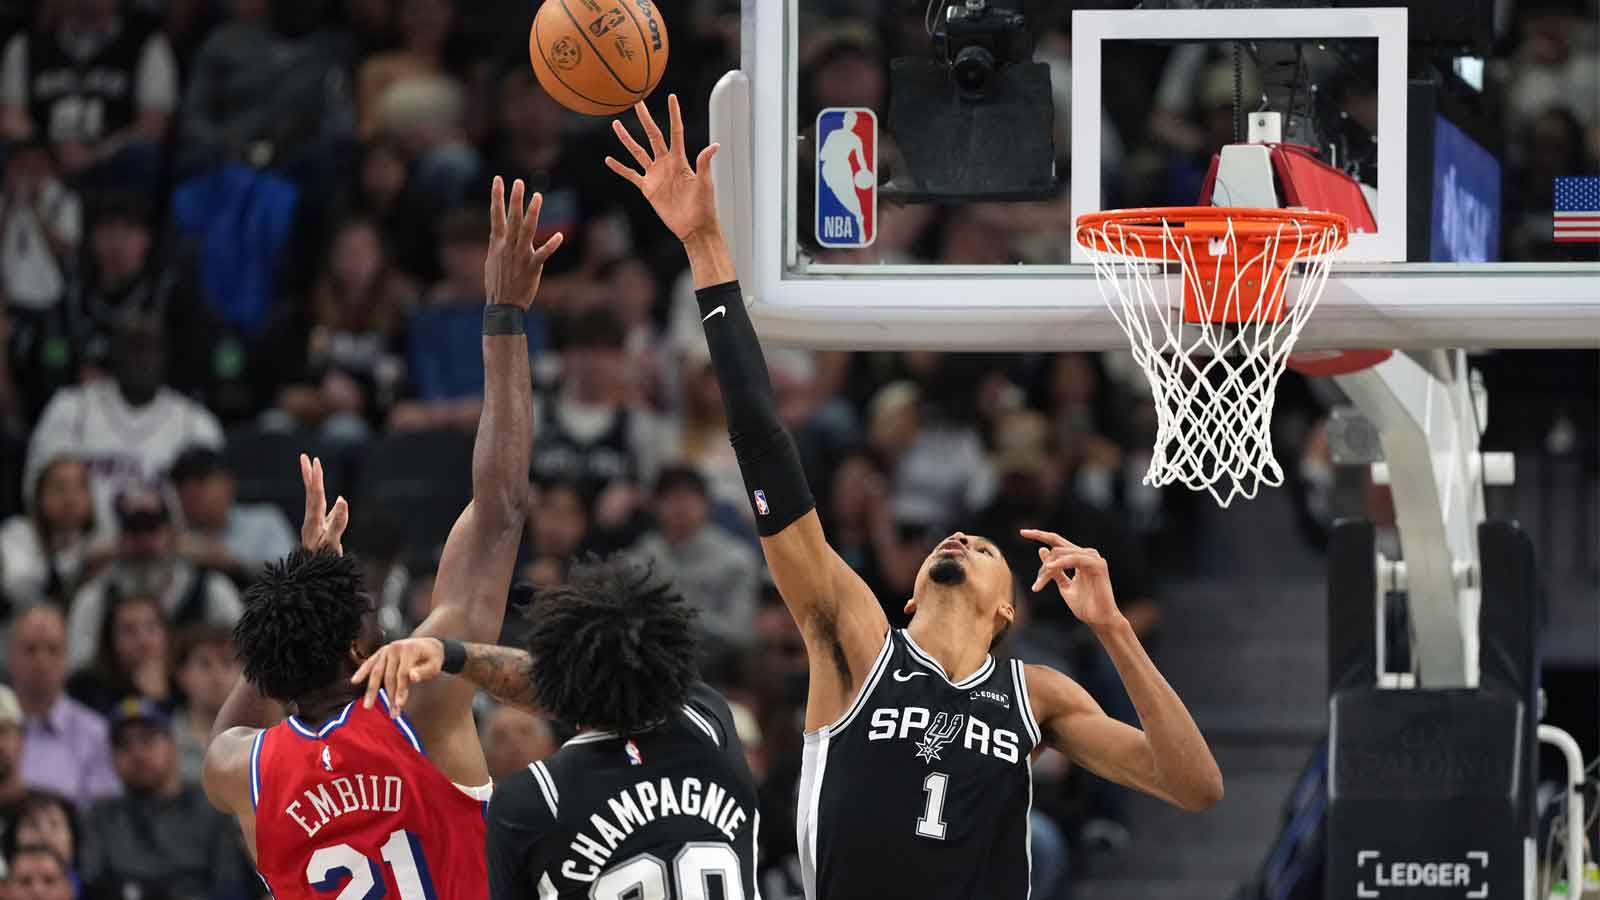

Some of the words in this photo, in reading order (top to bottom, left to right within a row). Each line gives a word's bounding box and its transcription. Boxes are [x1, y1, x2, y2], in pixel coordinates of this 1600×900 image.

[824, 215, 852, 238] NBA
[286, 773, 402, 838] EMBIID
[561, 776, 747, 883] CHAMPAGNIE
[916, 771, 949, 840] 1
[1375, 862, 1471, 887] LEDGER
